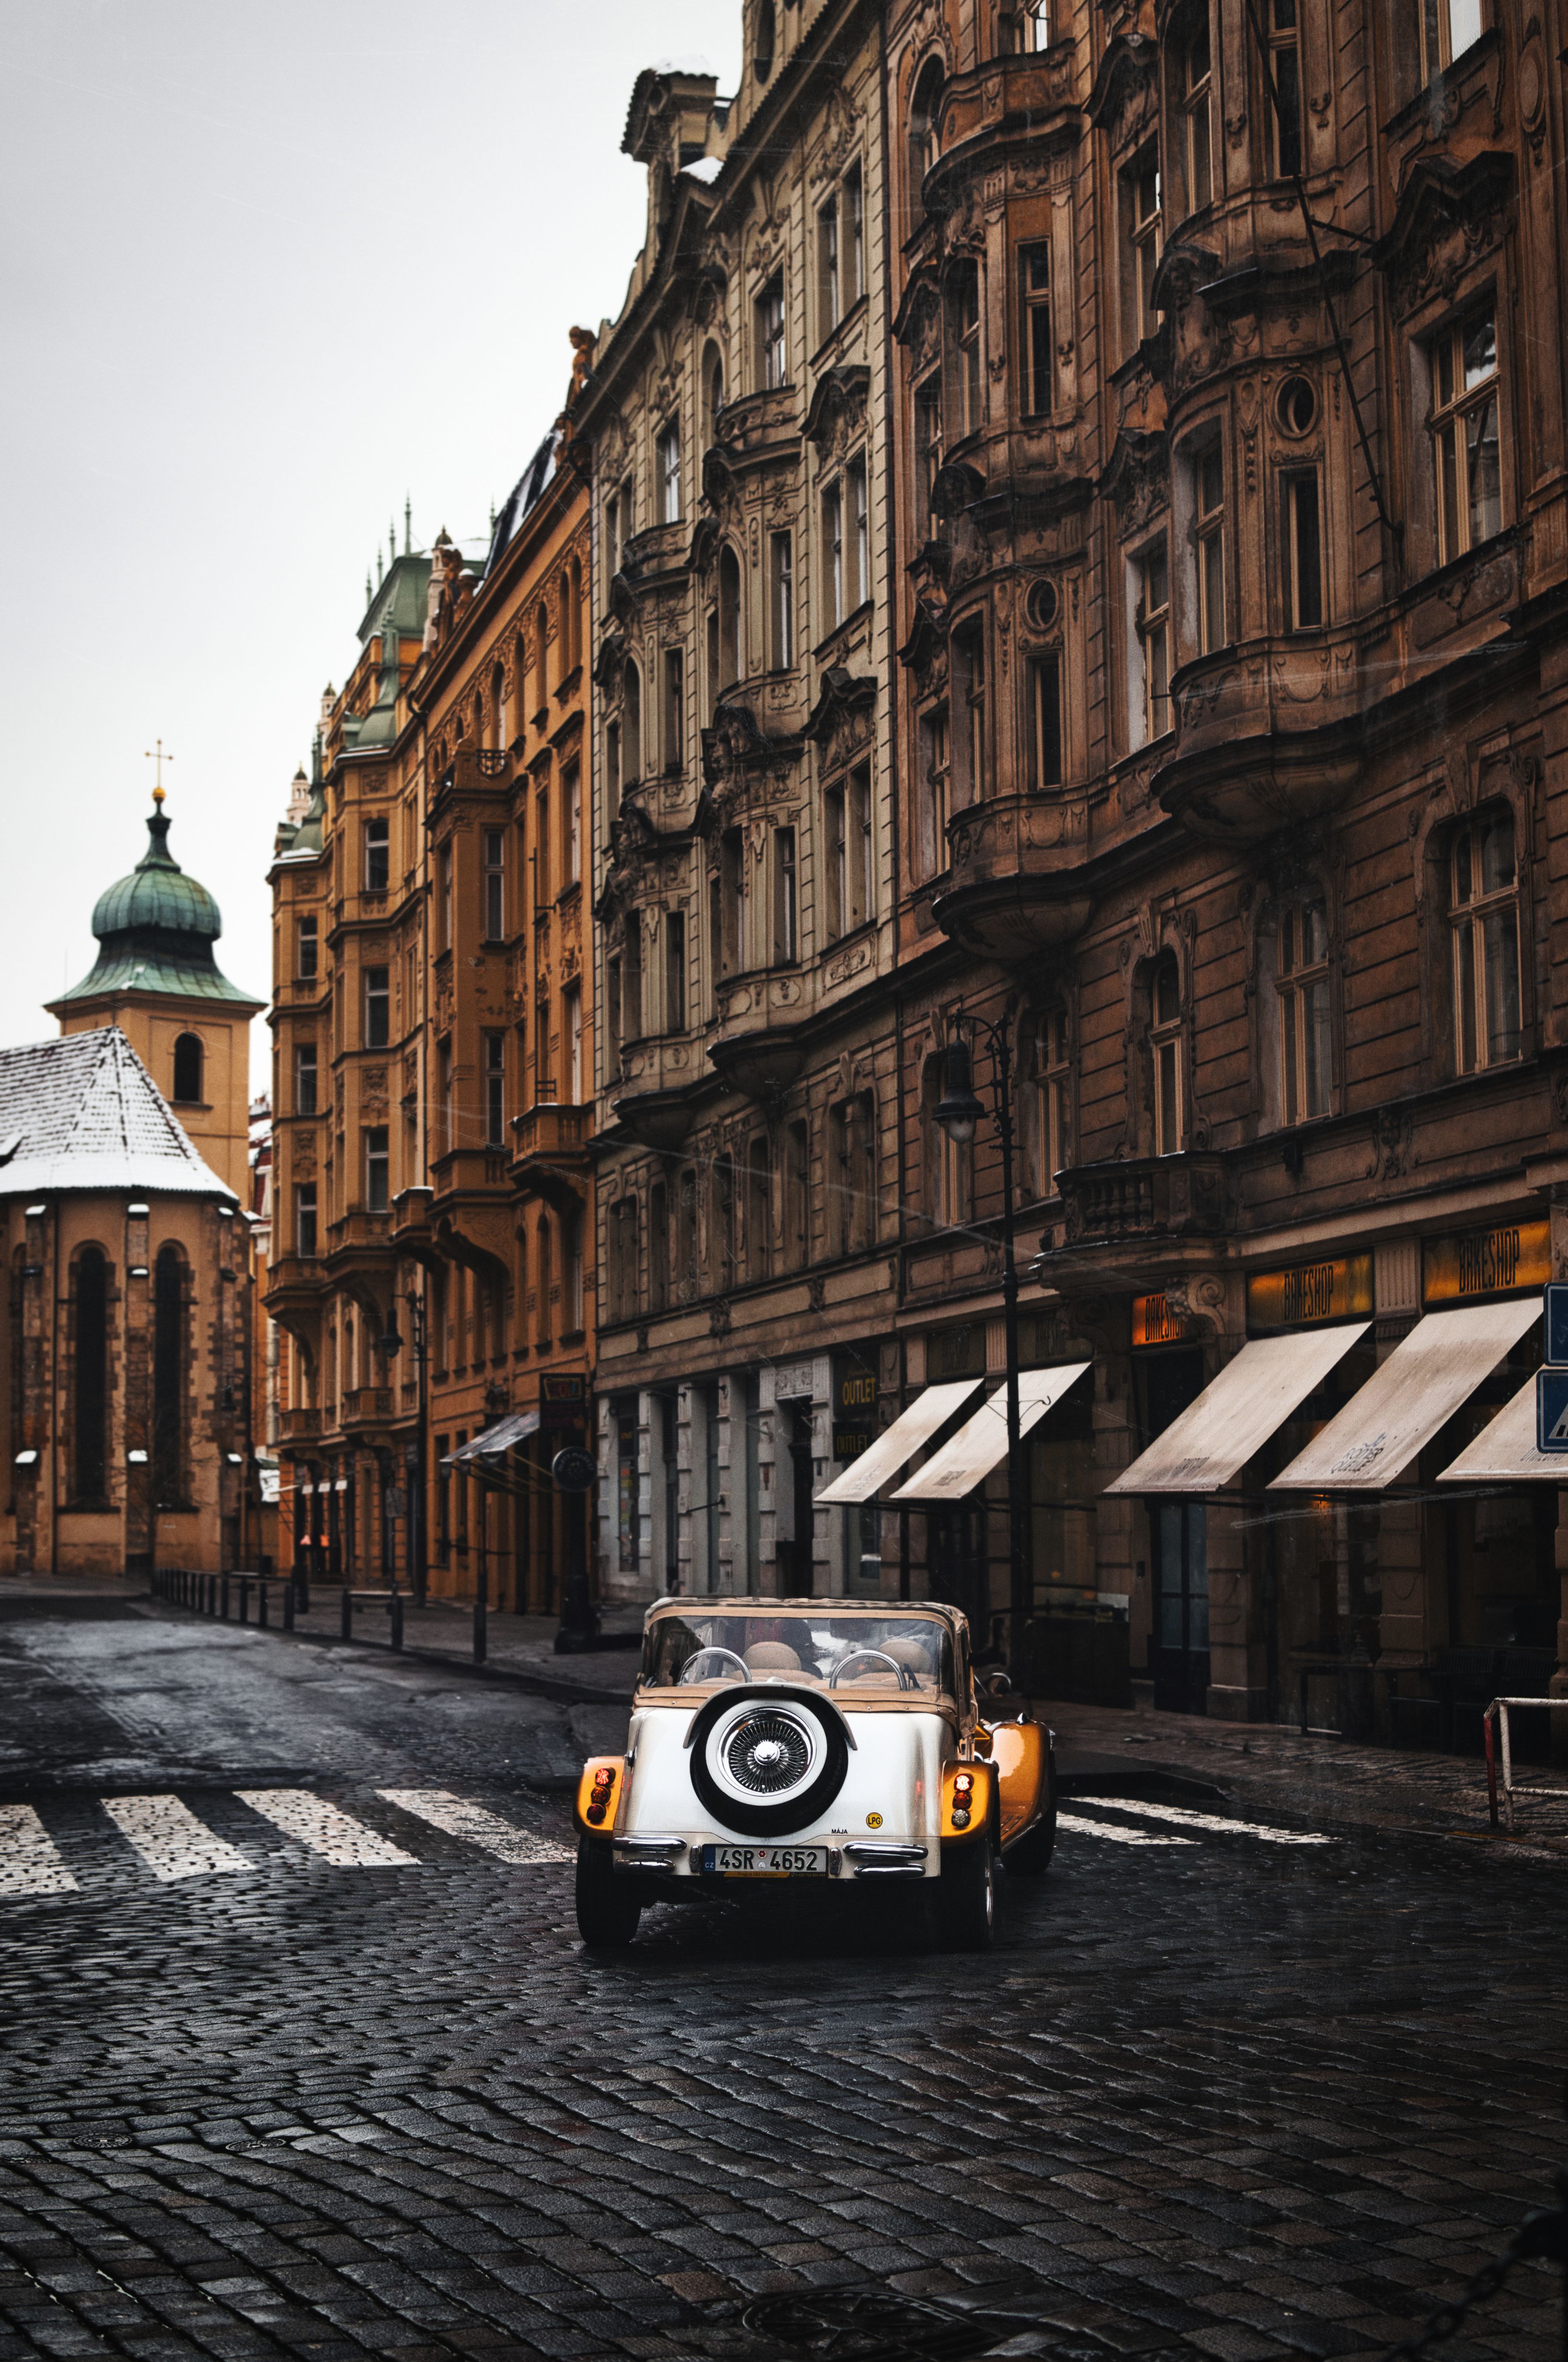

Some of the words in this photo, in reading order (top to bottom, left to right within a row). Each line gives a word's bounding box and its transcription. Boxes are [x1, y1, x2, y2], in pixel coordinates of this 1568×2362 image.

[1458, 1229, 1520, 1293] BAKESHOP
[1285, 1264, 1333, 1320] BAKESHOP
[843, 1377, 875, 1406] OUTLET
[837, 1435, 869, 1454] OUTLET
[868, 1817, 880, 1825] LPG
[720, 1849, 754, 1870] 4SR
[770, 1850, 817, 1870] 4652
